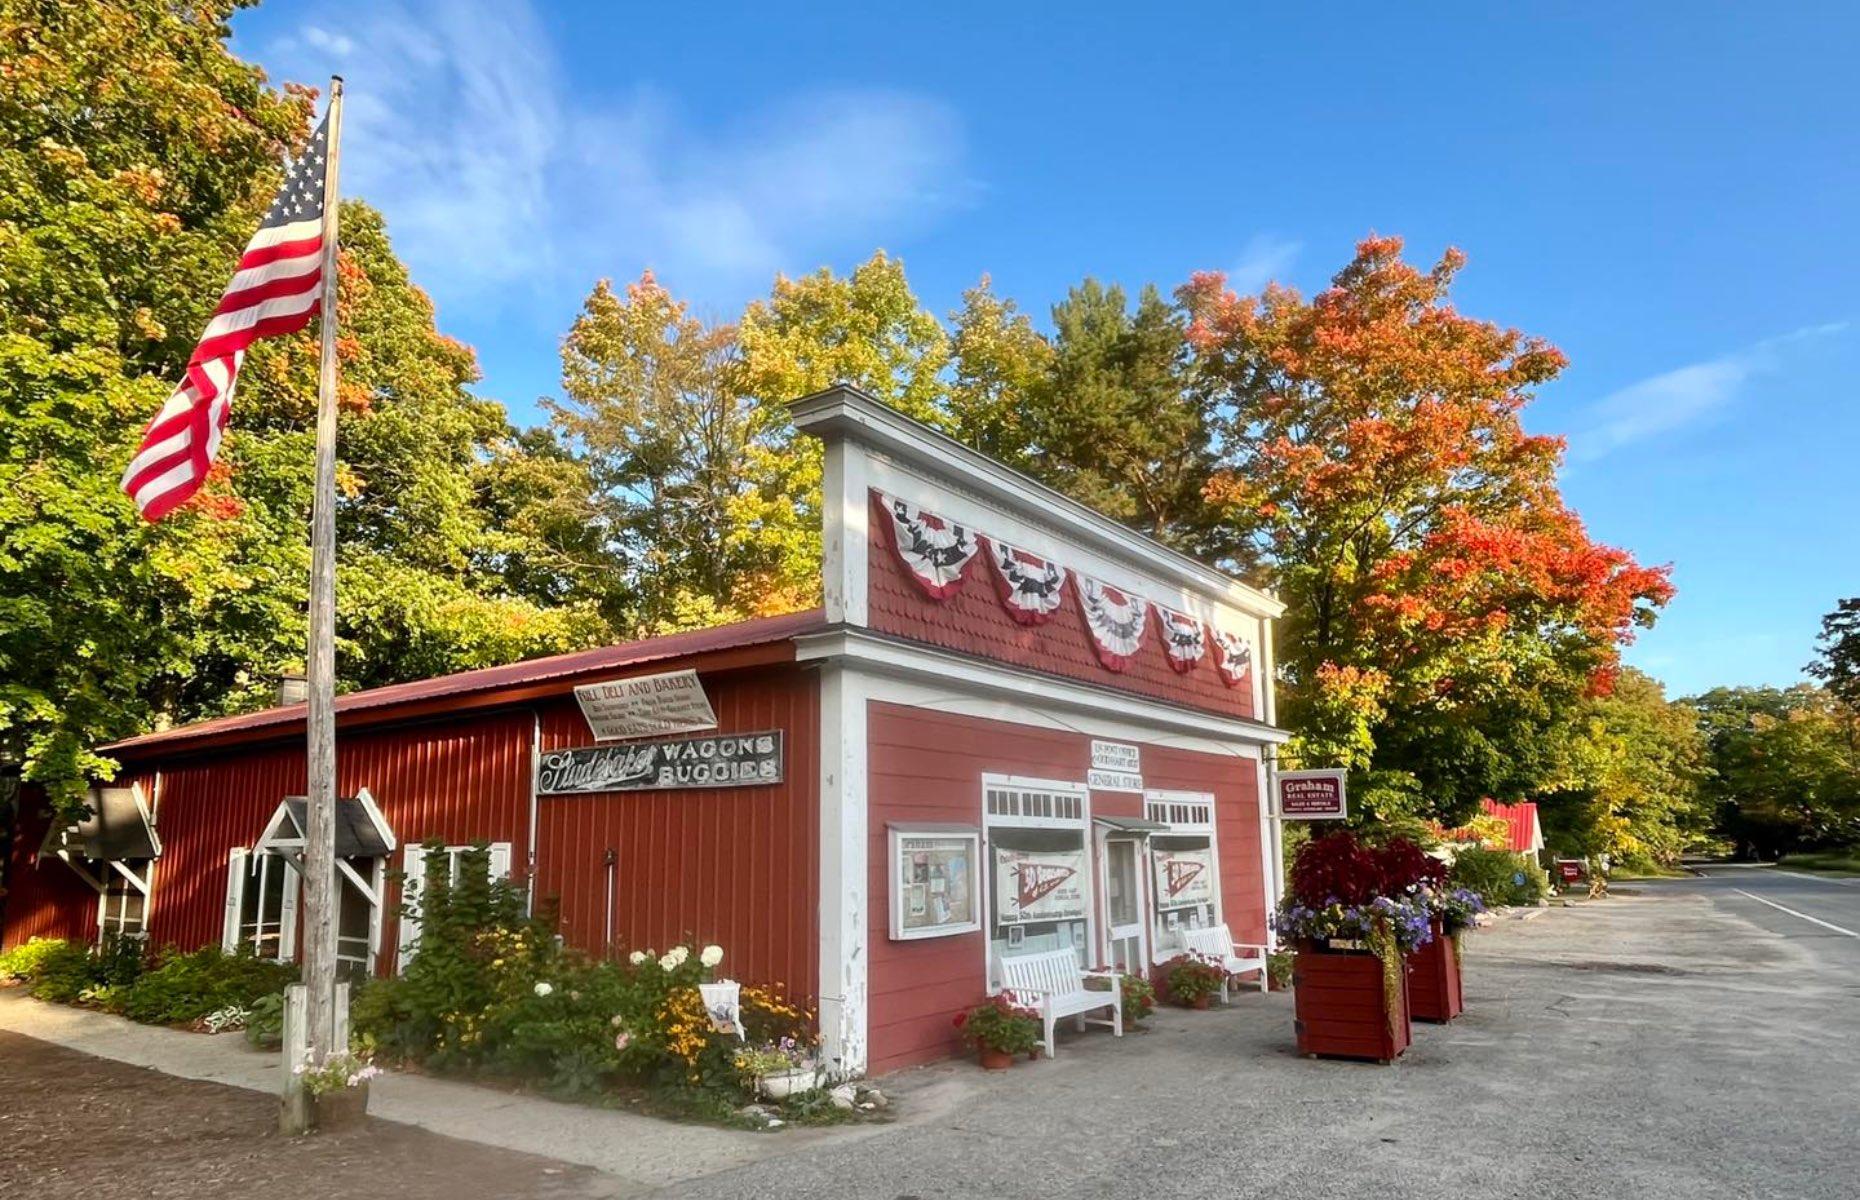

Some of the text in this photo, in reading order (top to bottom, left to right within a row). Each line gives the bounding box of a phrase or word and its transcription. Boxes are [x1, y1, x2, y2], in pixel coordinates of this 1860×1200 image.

[602, 685, 625, 700] DELI
[628, 681, 651, 697] AND
[653, 673, 697, 693] BAKERY
[662, 736, 774, 761] WAGONS
[540, 744, 658, 792] Studebaker
[659, 760, 777, 787] BUGGIES
[1090, 772, 1120, 787] GENERAL
[1286, 780, 1334, 792] Graham
